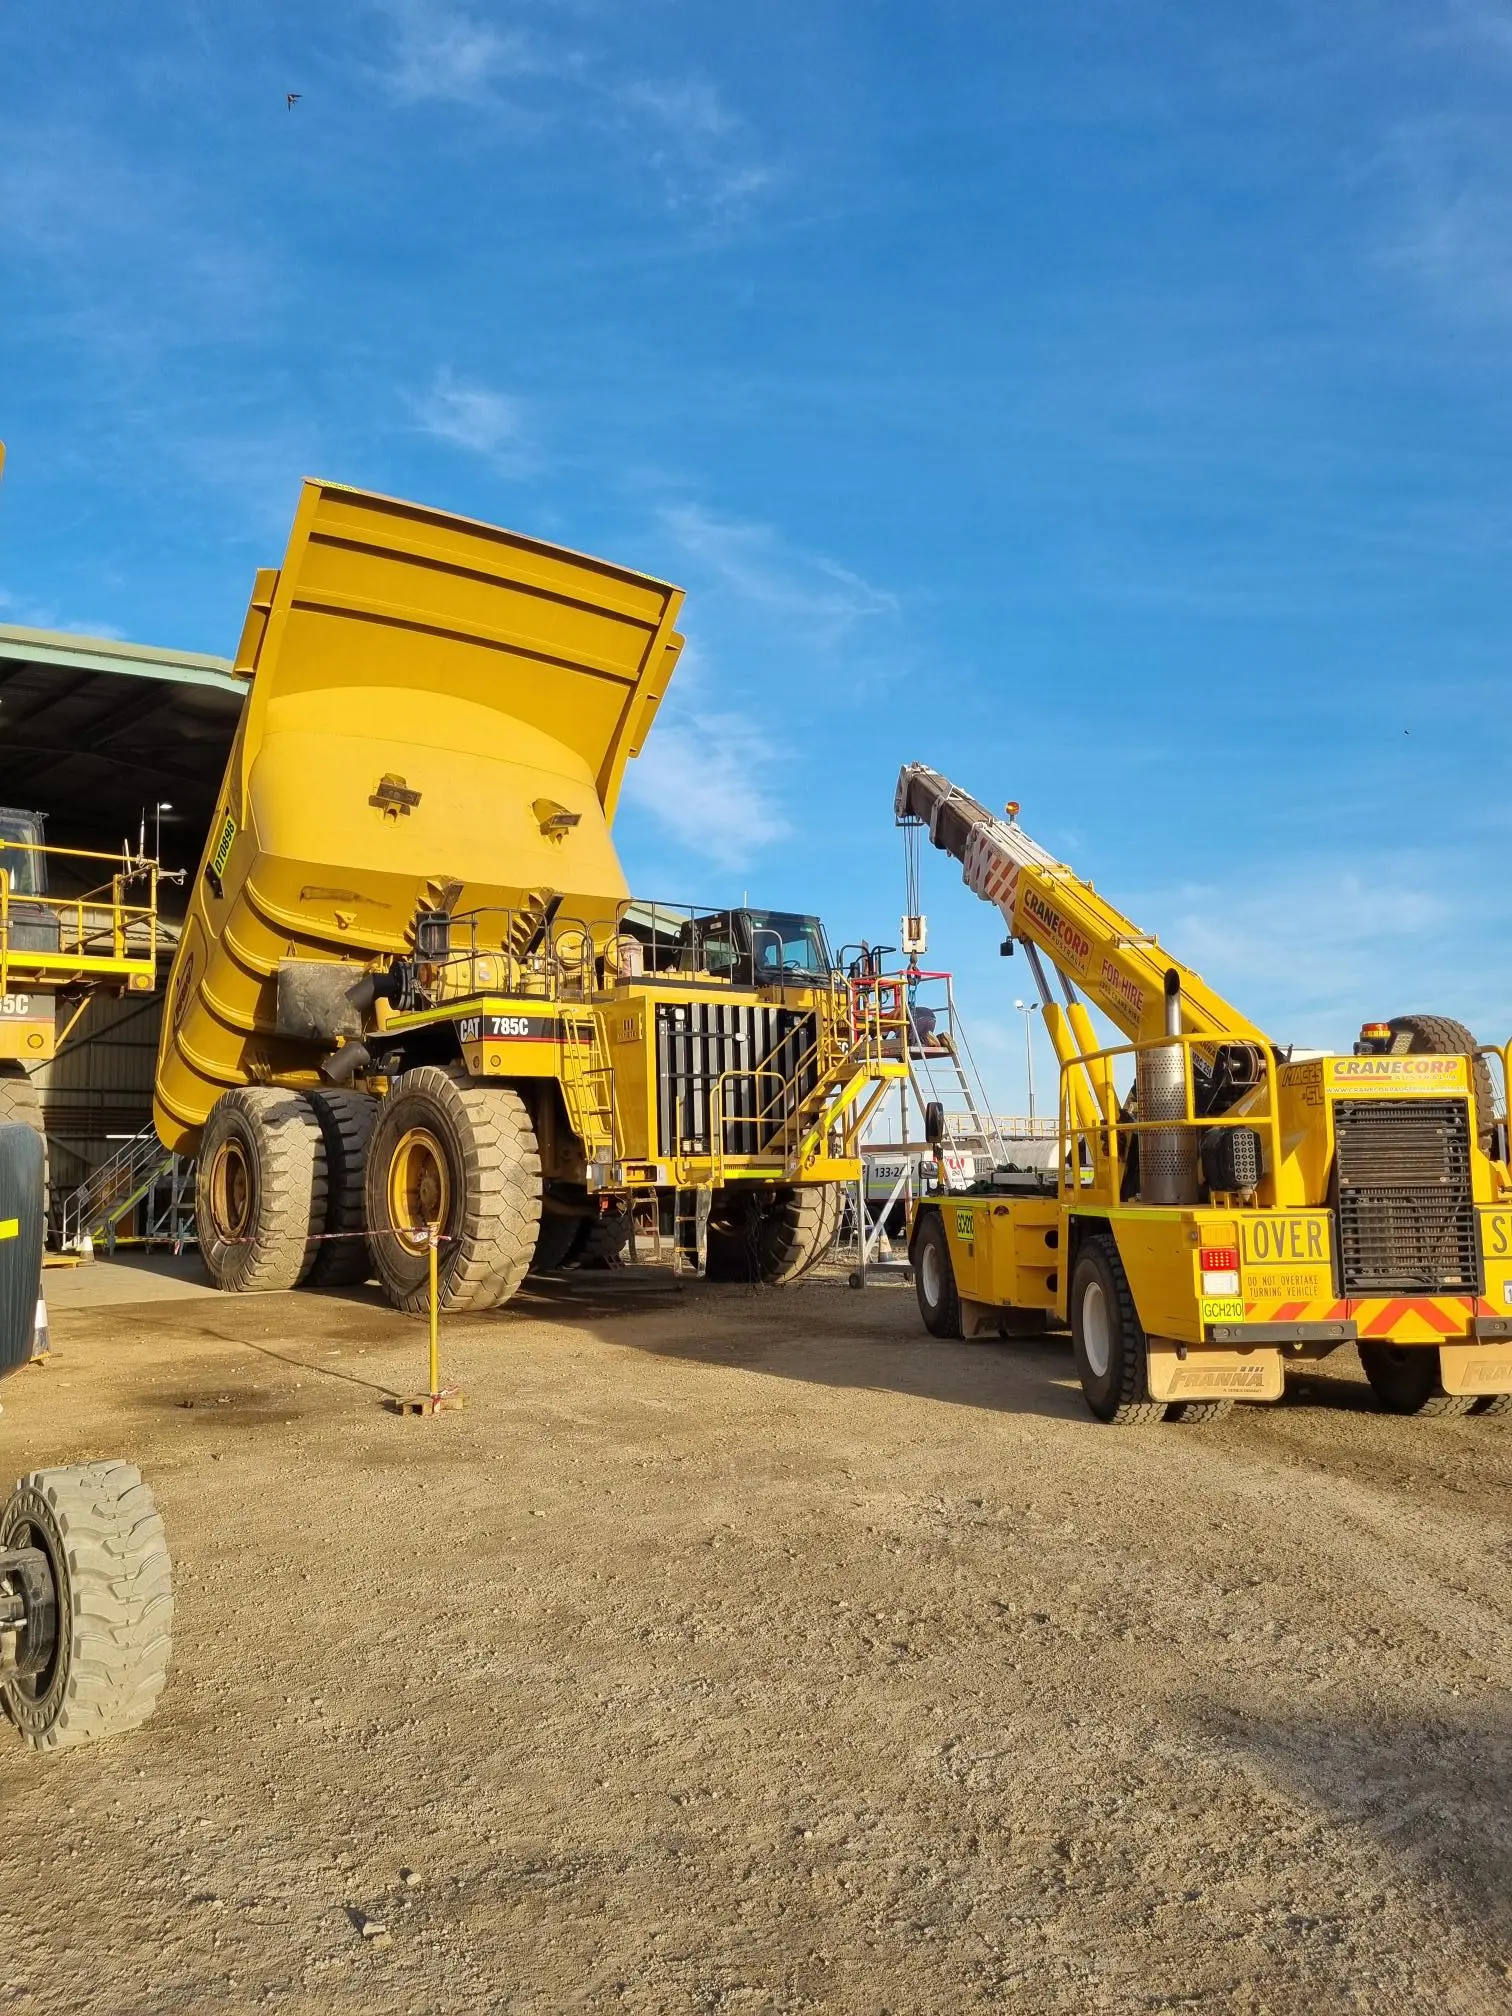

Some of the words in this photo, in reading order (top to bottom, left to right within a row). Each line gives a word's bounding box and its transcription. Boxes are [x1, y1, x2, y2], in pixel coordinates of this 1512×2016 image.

[214, 820, 235, 874] DT0898
[1024, 889, 1090, 958] CRANECORP
[1051, 935, 1086, 972] AUSTRALIA
[1101, 958, 1120, 989] FOR
[1121, 976, 1144, 1011] HIRE
[0, 994, 29, 1015] 5C
[460, 1018, 480, 1042] CAT
[492, 1018, 529, 1035] 785C
[1333, 1060, 1458, 1075] CRANECORP
[1253, 1220, 1323, 1258] OVER
[1491, 1215, 1512, 1254] S
[1247, 1276, 1257, 1287] DO
[1262, 1276, 1276, 1286] NOT
[1280, 1275, 1319, 1286] OVERTAKE
[1249, 1287, 1282, 1297] TURNING
[1286, 1286, 1318, 1297] VEHICLE
[1204, 1303, 1242, 1317] GCH210
[1167, 1367, 1265, 1394] FRANNA
